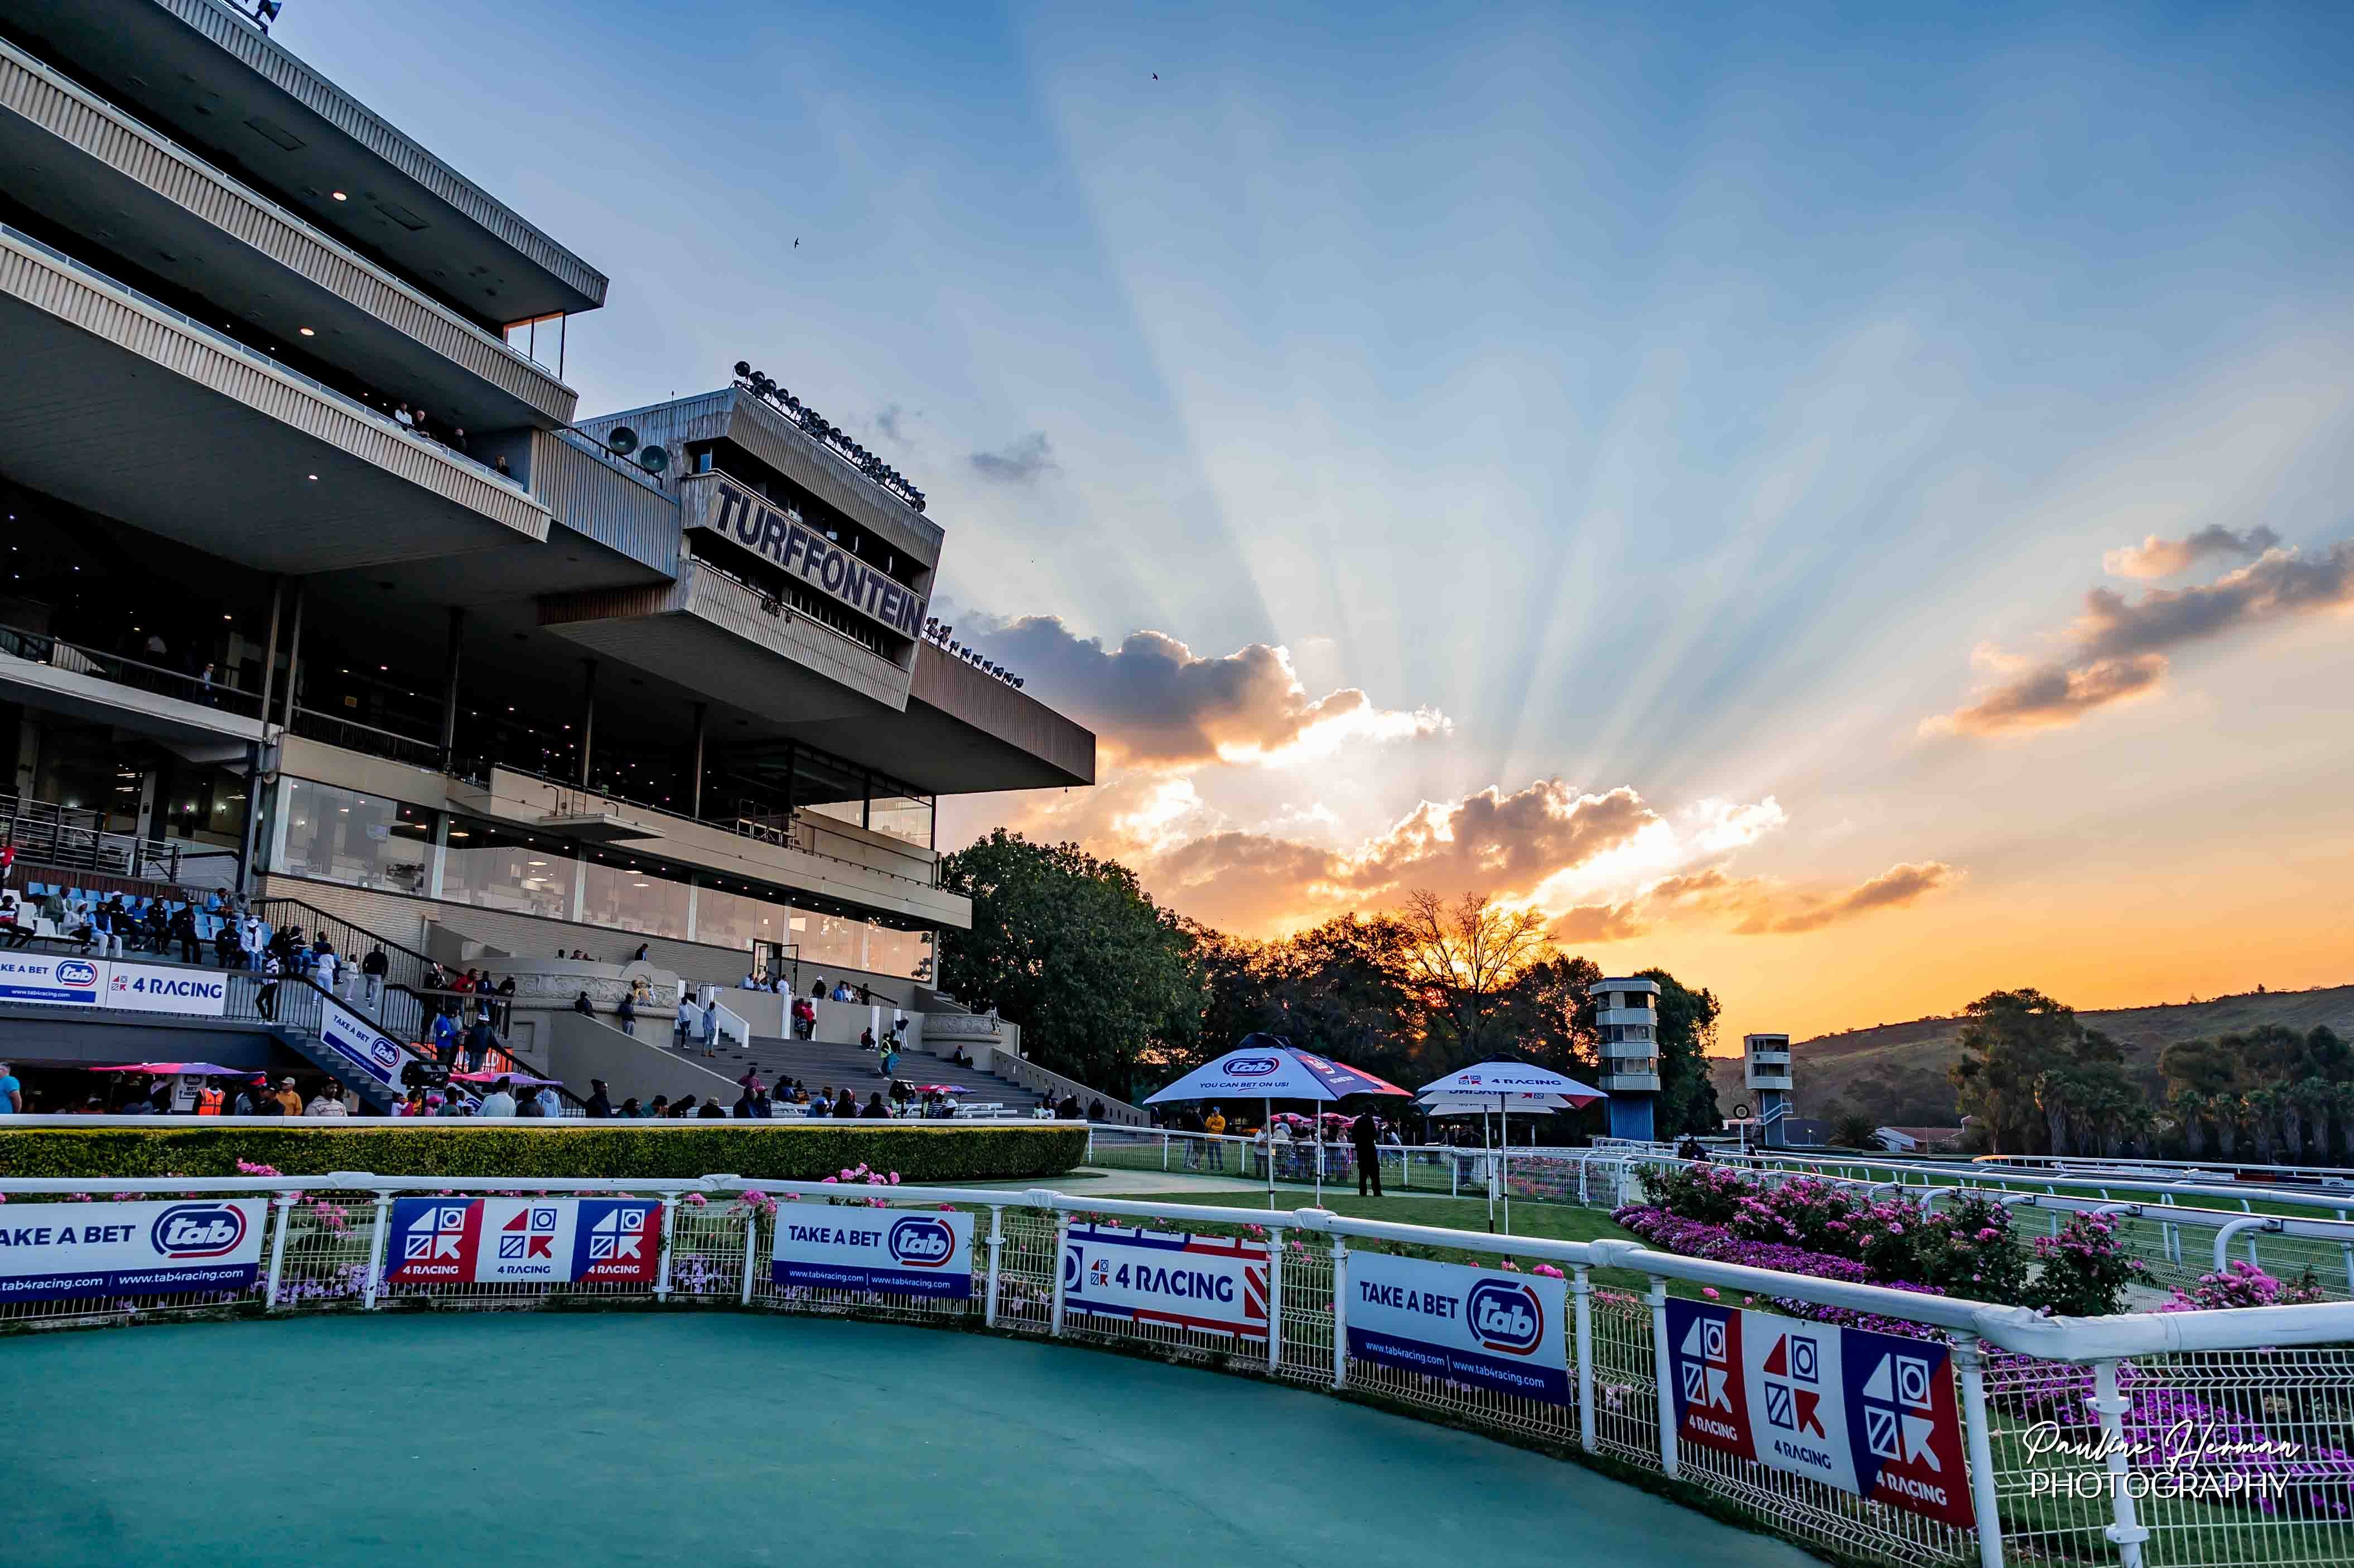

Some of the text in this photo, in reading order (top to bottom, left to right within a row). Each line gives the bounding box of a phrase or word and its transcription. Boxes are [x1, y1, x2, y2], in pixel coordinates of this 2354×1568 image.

[718, 481, 926, 638] TURFFONTEIN
[0, 963, 50, 974] KE A BET
[133, 977, 223, 999] 4 RACING
[334, 1015, 351, 1030] TAKE
[356, 1030, 370, 1043] BET
[1231, 1062, 1272, 1072] tab
[0, 1224, 136, 1247] AKE A BET
[165, 1217, 235, 1245] tab
[788, 1225, 882, 1248] TAKE A BET
[898, 1228, 946, 1255] tab
[0, 1269, 244, 1291] tab4racing.com www.tab4racing.com
[402, 1265, 459, 1275] 4 RACING
[497, 1265, 551, 1274] 4 RACING
[587, 1265, 640, 1274] 4 RACING
[789, 1269, 951, 1290] www.tab4racing.com www.tab4racing.com
[1116, 1263, 1233, 1302] 4 RACING
[1359, 1281, 1459, 1319] TAKE A BET
[1478, 1296, 1534, 1338] tab
[1365, 1342, 1545, 1389] www.tab4racing.com www.tab4racing.com
[1689, 1413, 1738, 1441] 4 RACING
[1774, 1440, 1832, 1470] 4 RACING
[1875, 1470, 1947, 1507] 4 RACING
